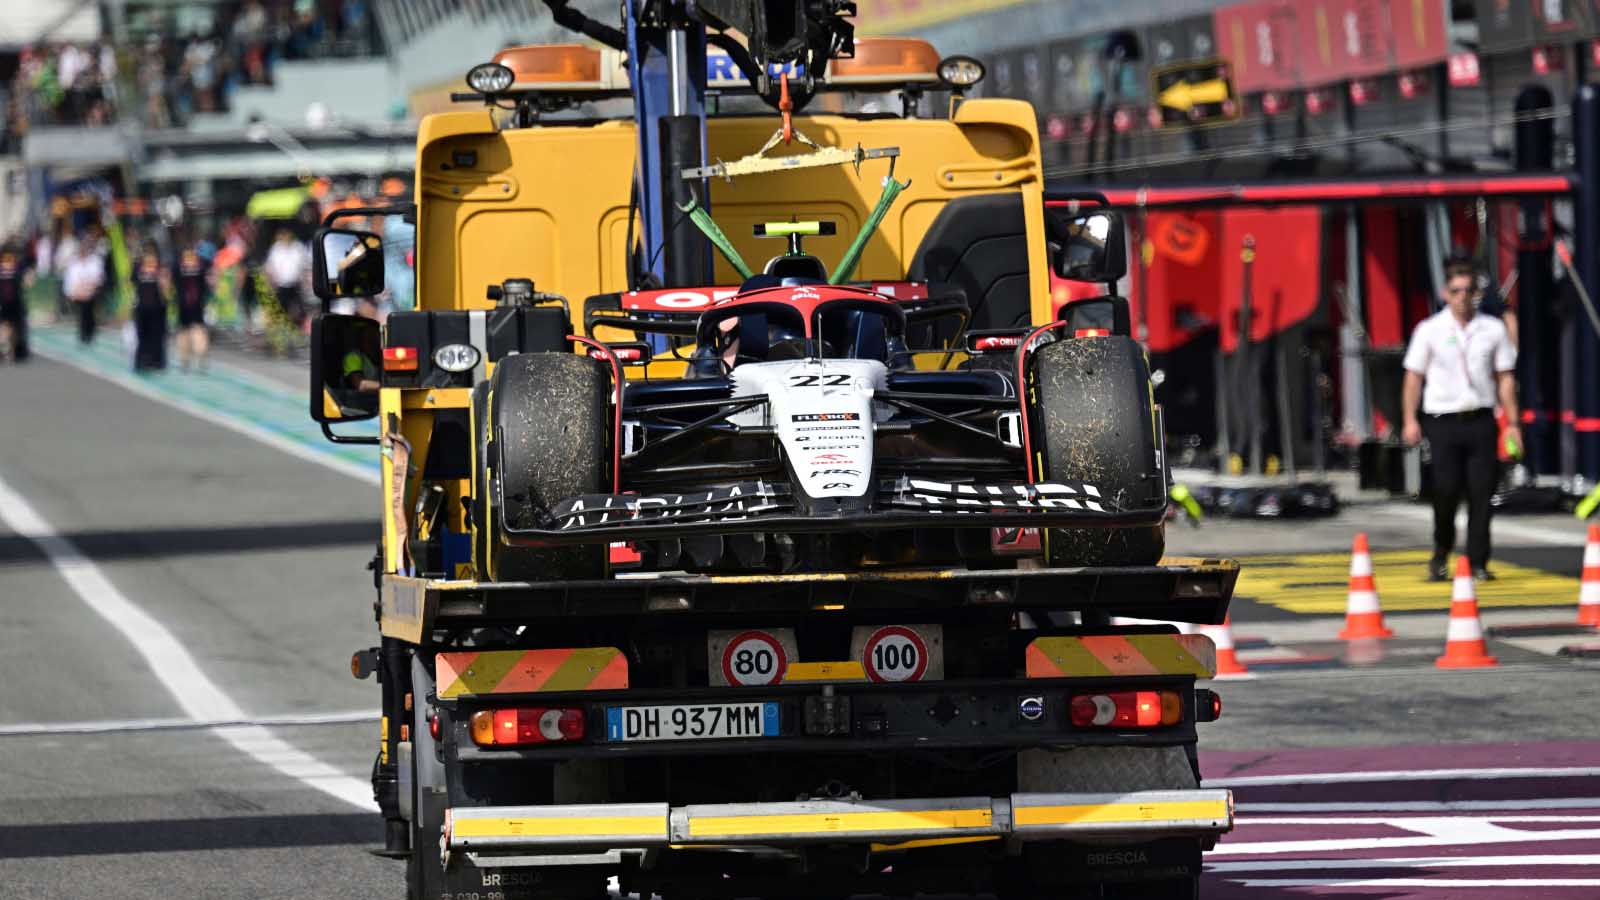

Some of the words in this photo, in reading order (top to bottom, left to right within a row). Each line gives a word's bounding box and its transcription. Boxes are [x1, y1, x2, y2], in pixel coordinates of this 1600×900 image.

[790, 374, 851, 387] 22
[797, 413, 854, 421] FLEXBOX
[735, 649, 773, 675] 80
[874, 643, 917, 671] 100
[626, 708, 660, 738] DH
[671, 705, 761, 737] 937MM
[1087, 850, 1148, 865] BRESCIA
